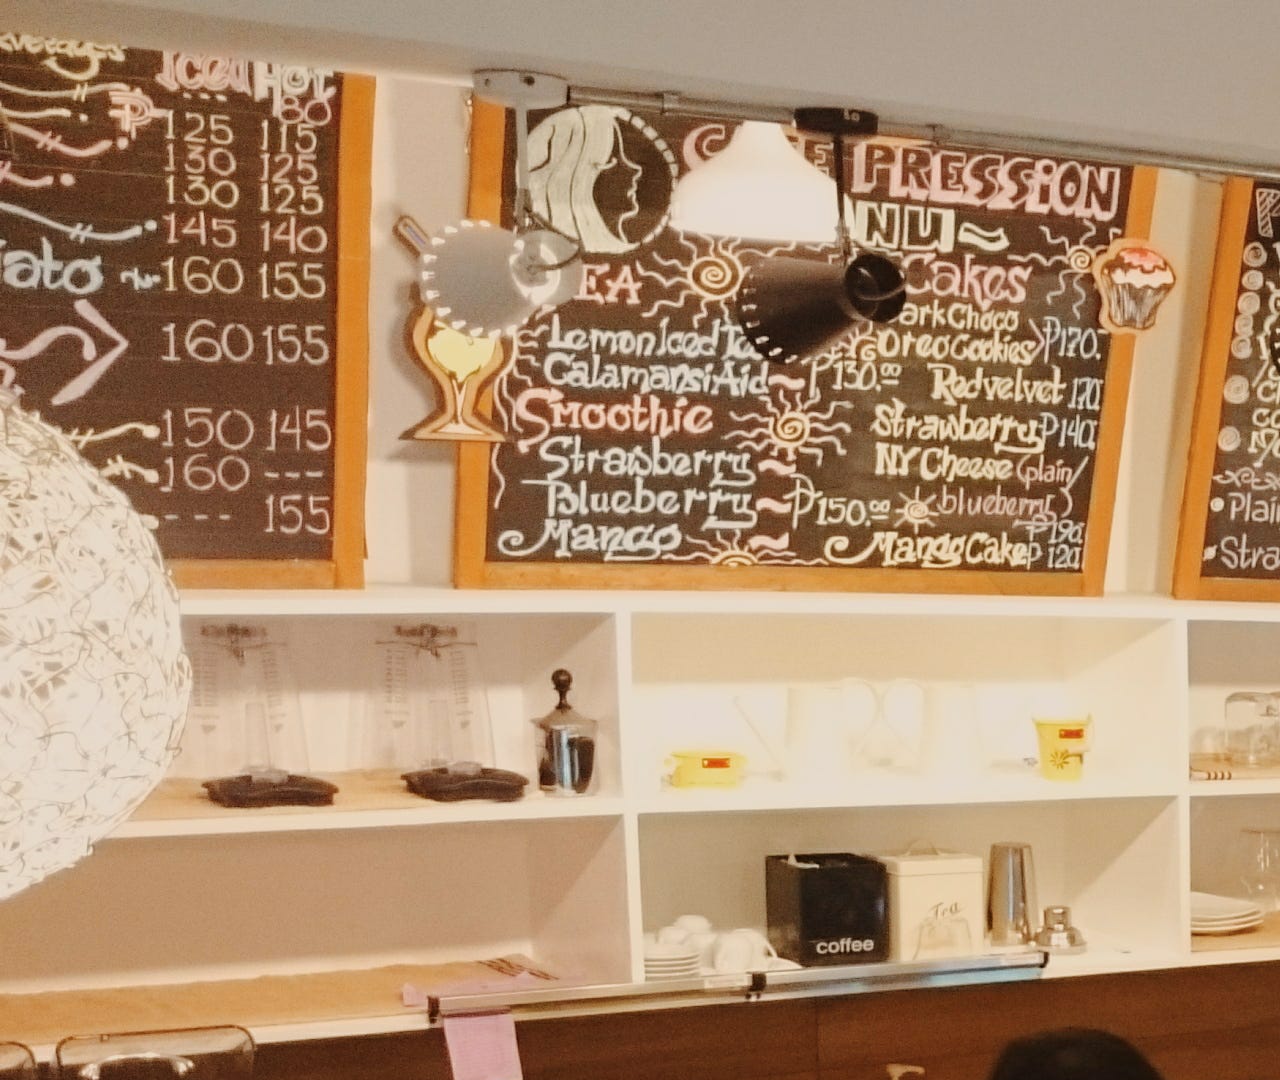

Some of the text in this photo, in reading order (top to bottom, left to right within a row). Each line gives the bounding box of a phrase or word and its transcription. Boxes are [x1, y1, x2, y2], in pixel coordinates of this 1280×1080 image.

[163, 111, 318, 153] 125 115
[164, 143, 318, 185] 130 125
[165, 175, 324, 216] 130 125
[161, 210, 328, 254] 145 140
[0, 236, 327, 300] ato 160 155
[573, 262, 645, 305] EA
[901, 252, 1034, 312] Cakes
[546, 313, 655, 358] Lemon
[658, 316, 724, 358] Iced
[895, 302, 1020, 333] ark Choco
[161, 318, 330, 366] 160 155
[876, 329, 950, 359] Oreo
[951, 334, 1037, 366] Cookies
[543, 352, 713, 395] Calamansi
[713, 361, 770, 397] Aid
[161, 405, 332, 452] 150 145
[870, 405, 1046, 454] Strawberry
[159, 453, 250, 493] 160
[538, 434, 757, 488] Strawberry
[874, 441, 922, 477] NY
[919, 445, 1014, 481] Cheese
[264, 494, 331, 534] 155
[511, 475, 758, 532] Blueberry
[497, 517, 684, 562] Mango
[823, 530, 965, 568] Mango
[965, 532, 1030, 566] Cake
[816, 937, 875, 955] coffee
